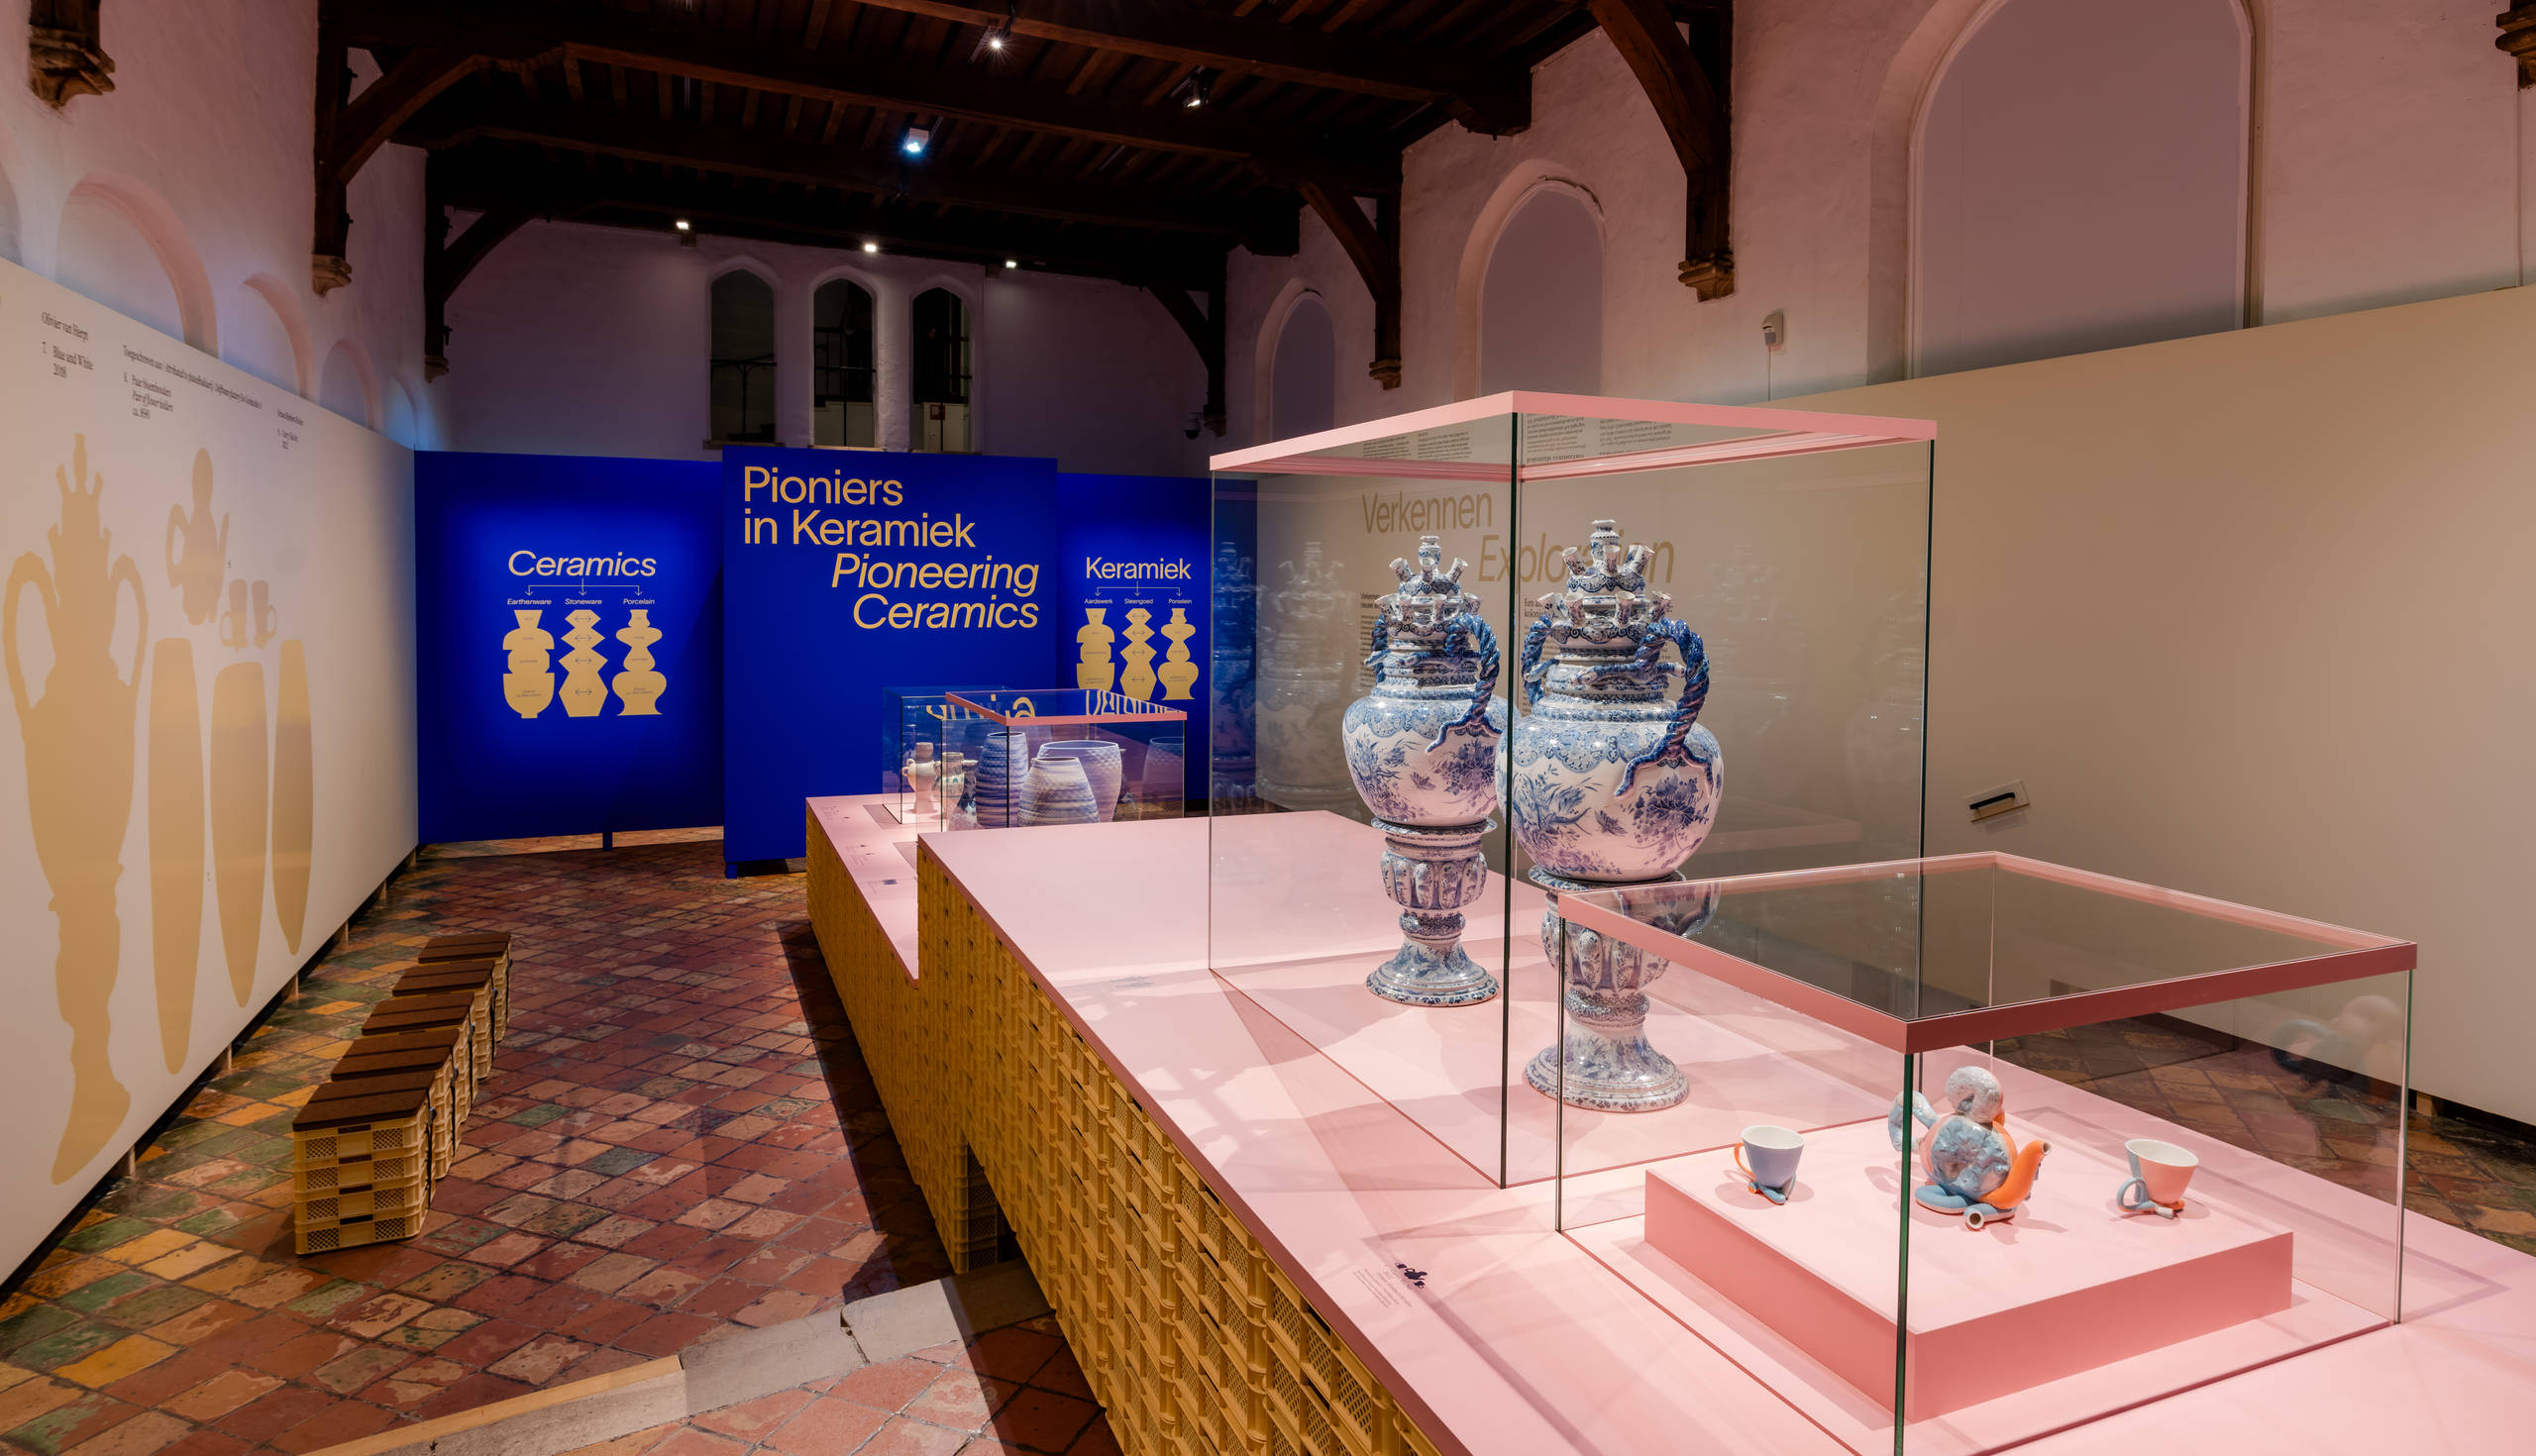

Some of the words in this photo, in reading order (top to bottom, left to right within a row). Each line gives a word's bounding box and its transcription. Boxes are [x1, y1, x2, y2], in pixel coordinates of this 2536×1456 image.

[744, 466, 903, 506] Pioniers
[744, 508, 779, 545] in
[792, 509, 977, 548] Keramiek
[1362, 491, 1493, 534] Verkennen
[507, 550, 658, 577] Ceramics
[831, 553, 1040, 597] Pioneering
[1086, 557, 1193, 579] Keramiek
[853, 593, 1040, 629] Ceramics
